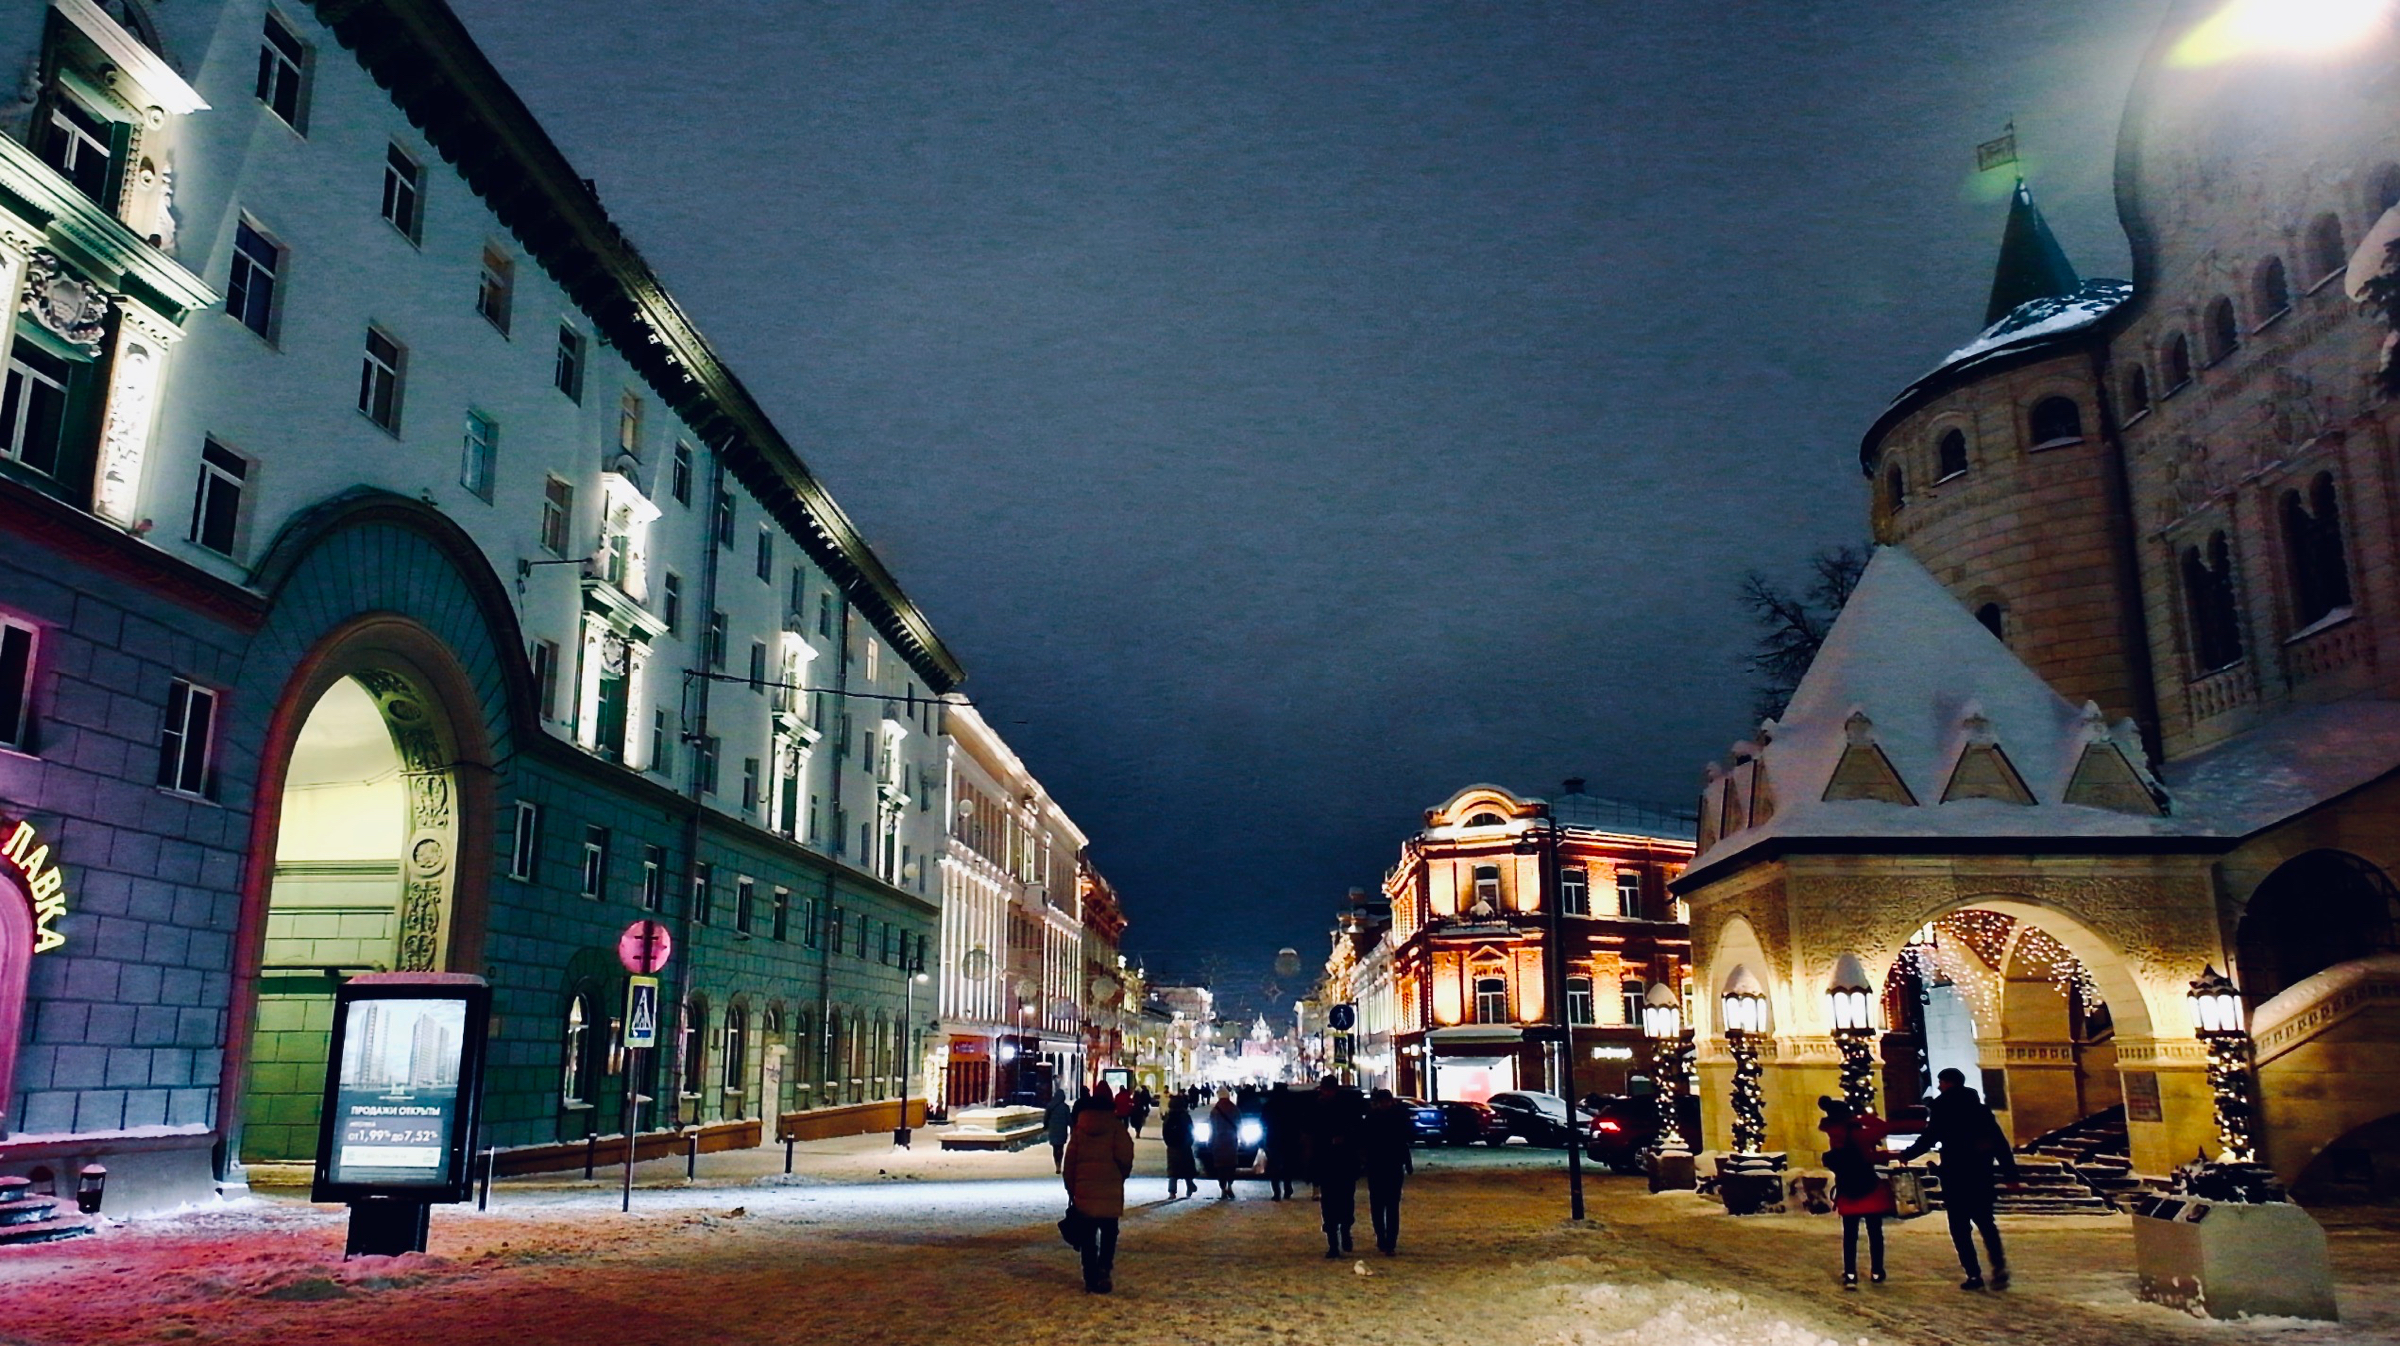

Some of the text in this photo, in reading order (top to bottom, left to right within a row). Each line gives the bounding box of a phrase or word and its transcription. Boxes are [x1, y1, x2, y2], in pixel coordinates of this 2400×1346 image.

[1, 821, 67, 954] ЛАВКА
[351, 1105, 441, 1116] ПРОДАЖИ ОТКРЫТЫ
